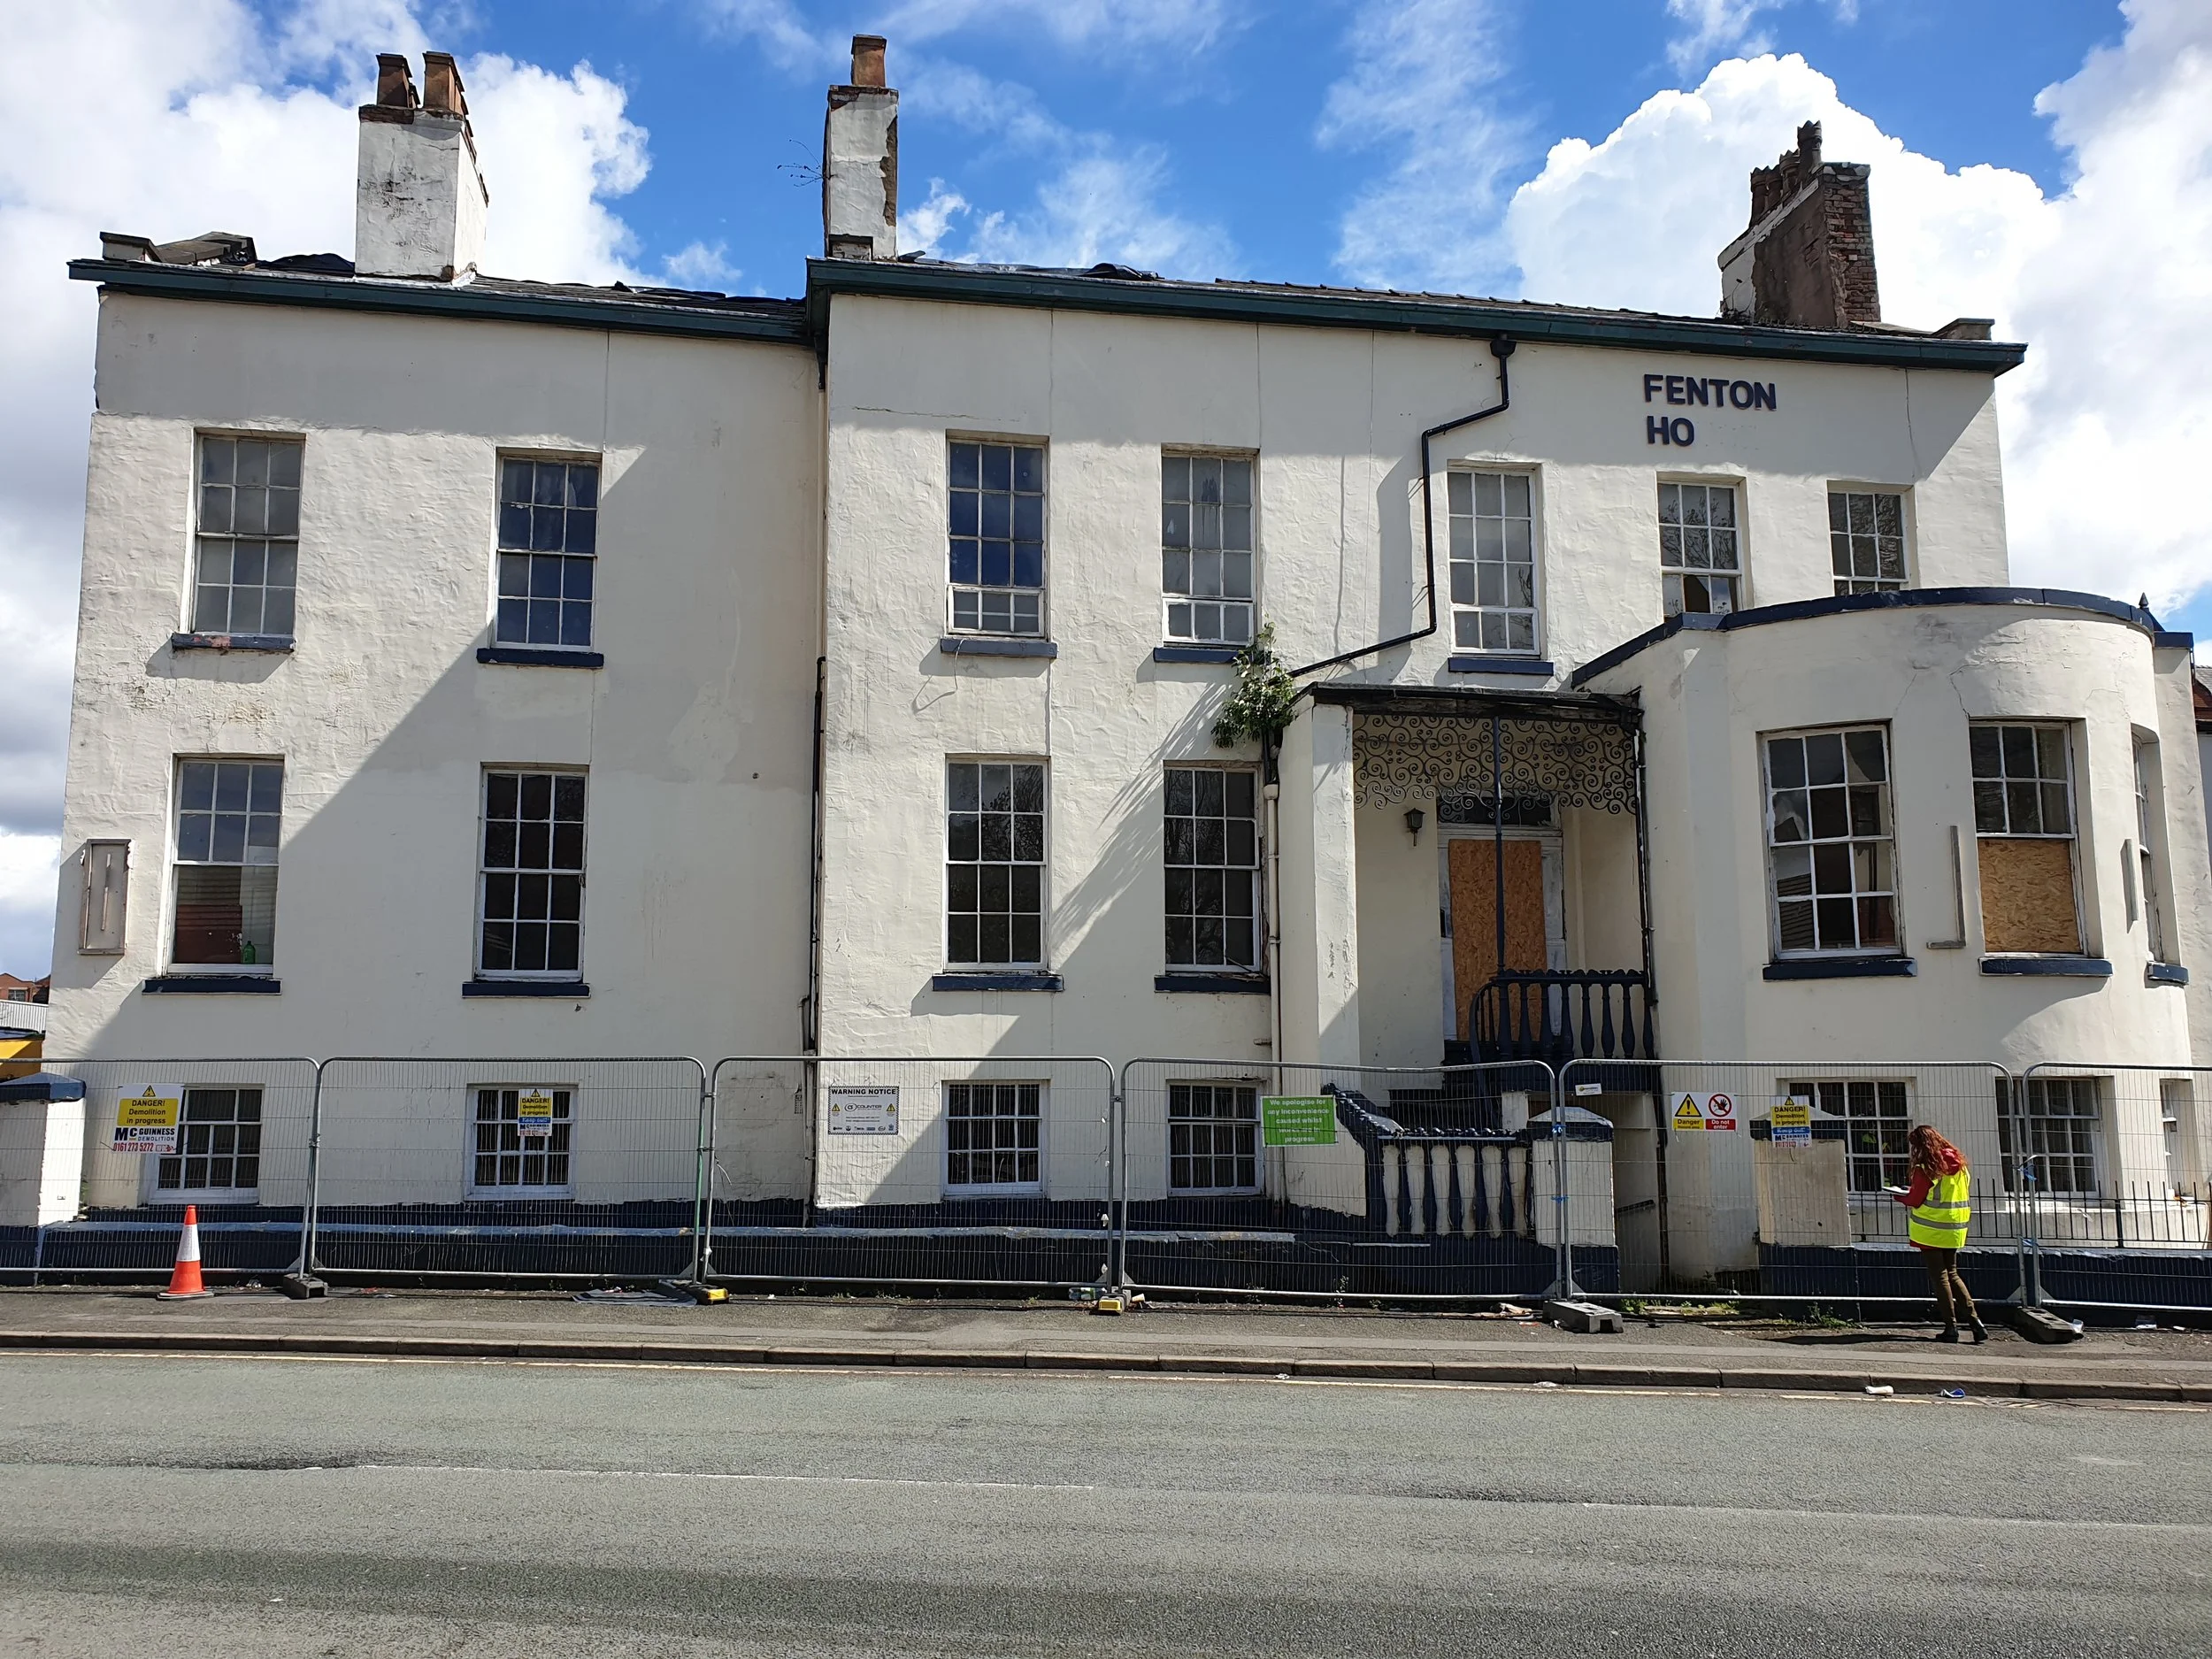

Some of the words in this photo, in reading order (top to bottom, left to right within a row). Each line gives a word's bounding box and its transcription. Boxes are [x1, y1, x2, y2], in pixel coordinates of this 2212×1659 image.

[1644, 373, 1777, 411] FENTON
[1647, 415, 1694, 447] HO
[113, 1142, 127, 1151] 0161
[127, 1142, 139, 1151] 273
[139, 1142, 154, 1151] 5272
